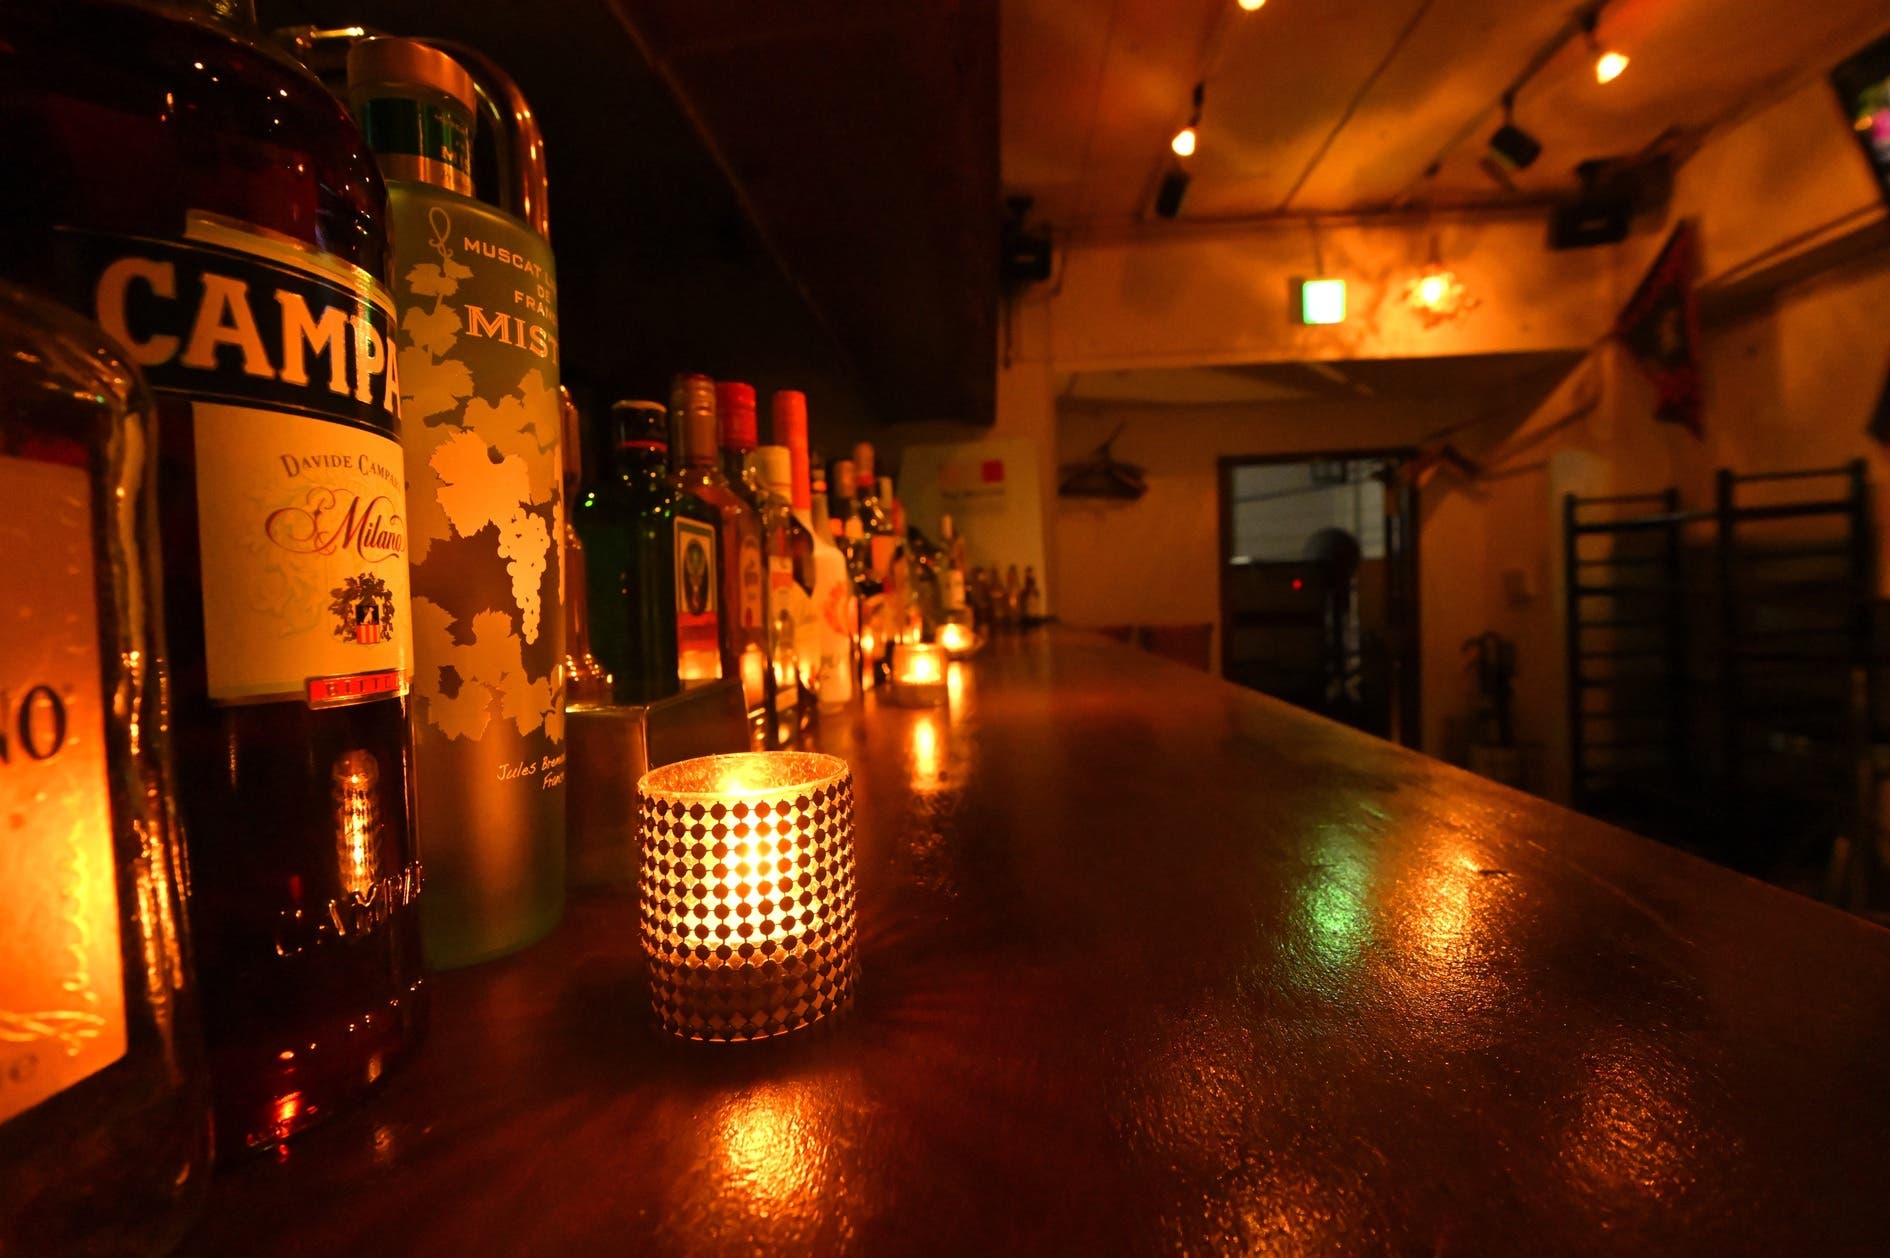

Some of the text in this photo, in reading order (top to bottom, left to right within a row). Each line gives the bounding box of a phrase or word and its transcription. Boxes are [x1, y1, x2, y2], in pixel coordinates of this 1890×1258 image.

[94, 257, 402, 420] CAMPA
[264, 486, 407, 564] Milano
[496, 760, 537, 781] Jules
